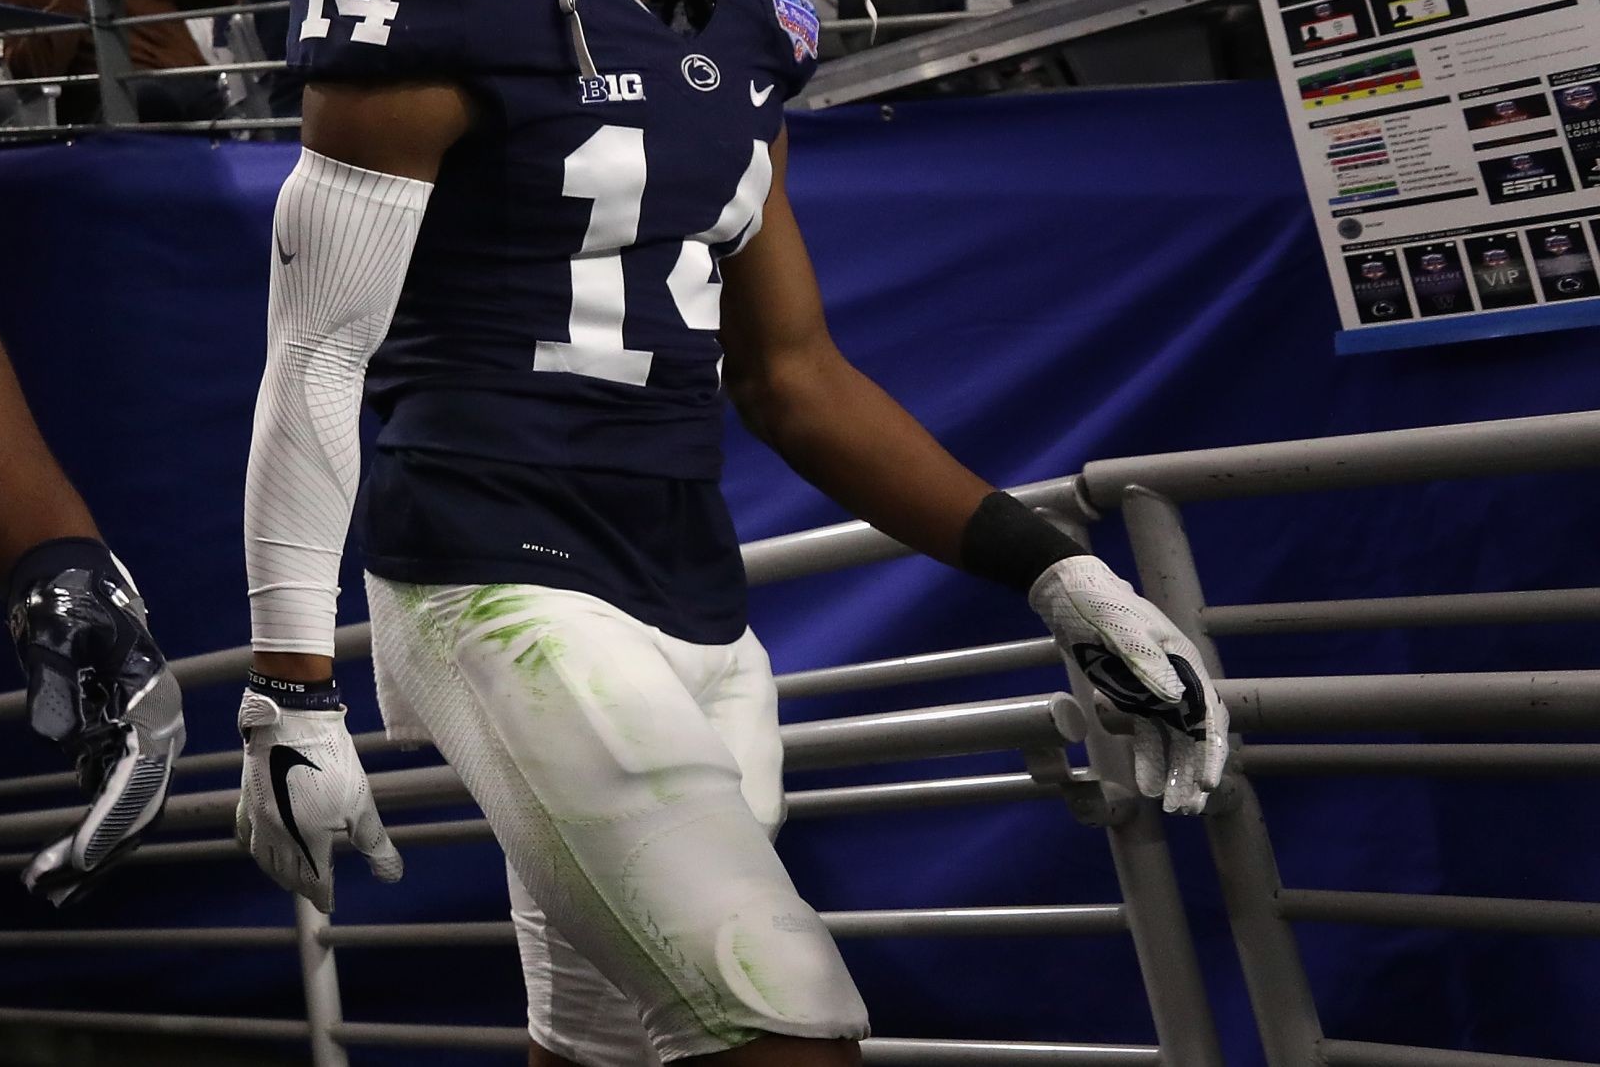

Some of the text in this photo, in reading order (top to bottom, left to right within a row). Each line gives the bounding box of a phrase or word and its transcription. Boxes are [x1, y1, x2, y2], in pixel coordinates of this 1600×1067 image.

[1502, 174, 1557, 195] ESPN
[532, 123, 773, 388] 14
[1484, 269, 1520, 287] VIP
[270, 680, 305, 693] CUTS
